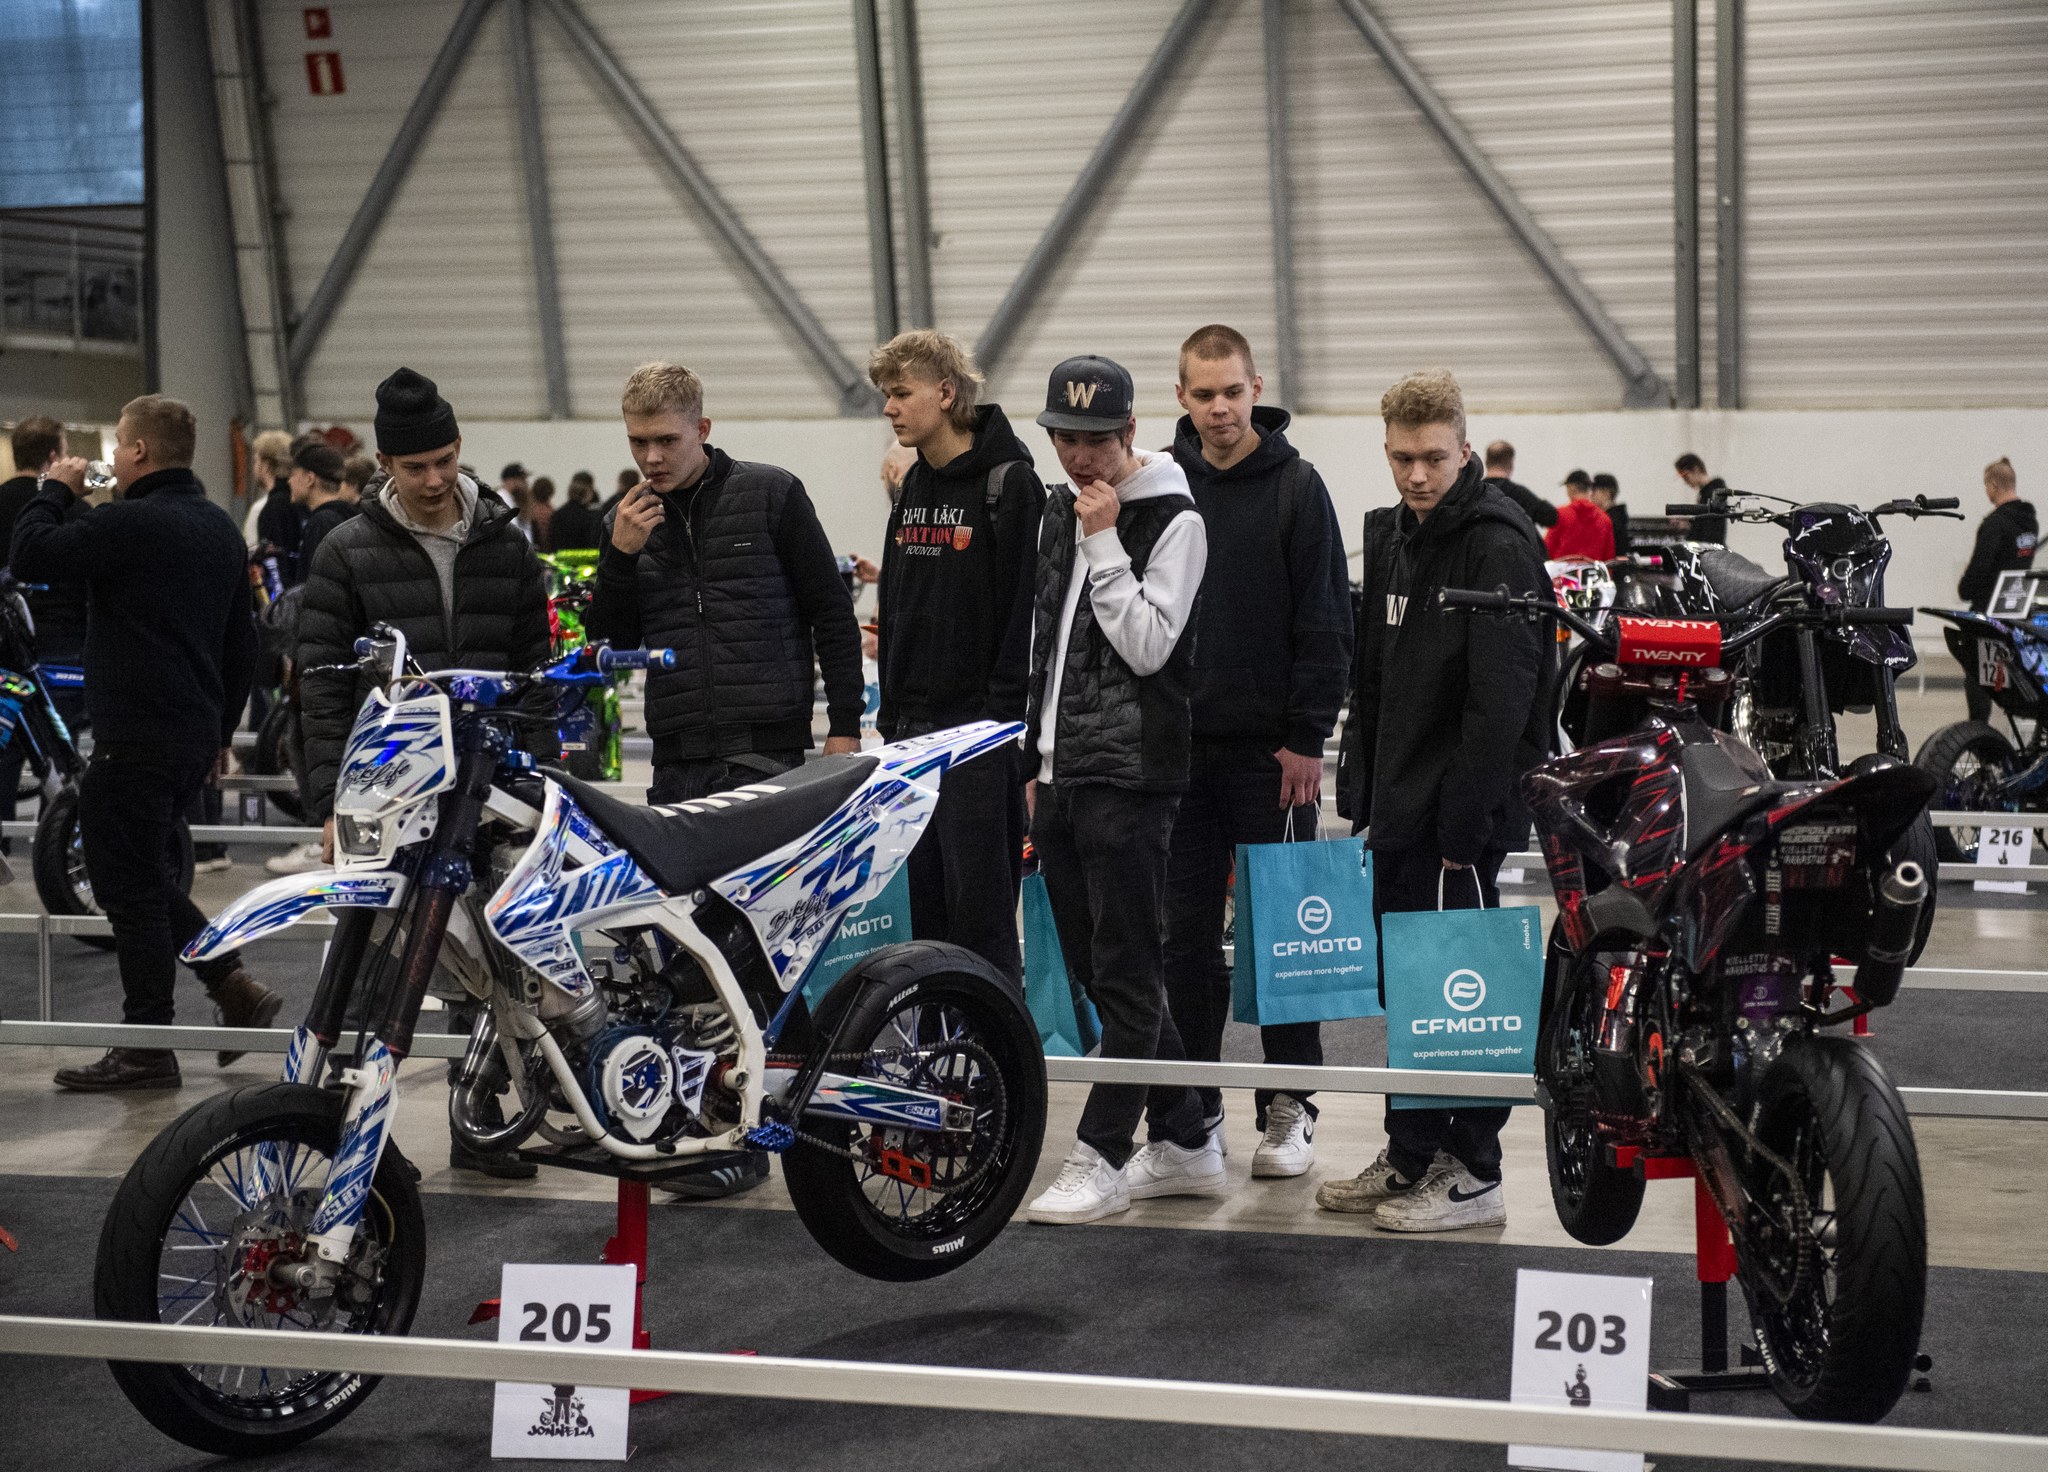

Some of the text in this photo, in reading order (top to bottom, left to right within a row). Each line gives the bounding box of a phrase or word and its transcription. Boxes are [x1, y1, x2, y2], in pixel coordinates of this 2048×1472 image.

[1066, 380, 1098, 409] W
[1632, 648, 1707, 662] TWENTY
[1988, 829, 2023, 847] 216
[832, 914, 893, 942] MOTO
[1521, 918, 1531, 950] cfmoto.fi
[1273, 936, 1362, 957] CFMOTO
[1275, 964, 1364, 980] experience more together
[886, 983, 919, 1012] Mitas
[1411, 1015, 1522, 1035] CFMOTO
[1413, 1045, 1523, 1060] experience more together
[932, 1235, 965, 1255] Mitas
[519, 1302, 612, 1344] 205
[1534, 1310, 1627, 1356] 203
[323, 1374, 361, 1410] Mitas
[527, 1424, 595, 1438] JONNELA
